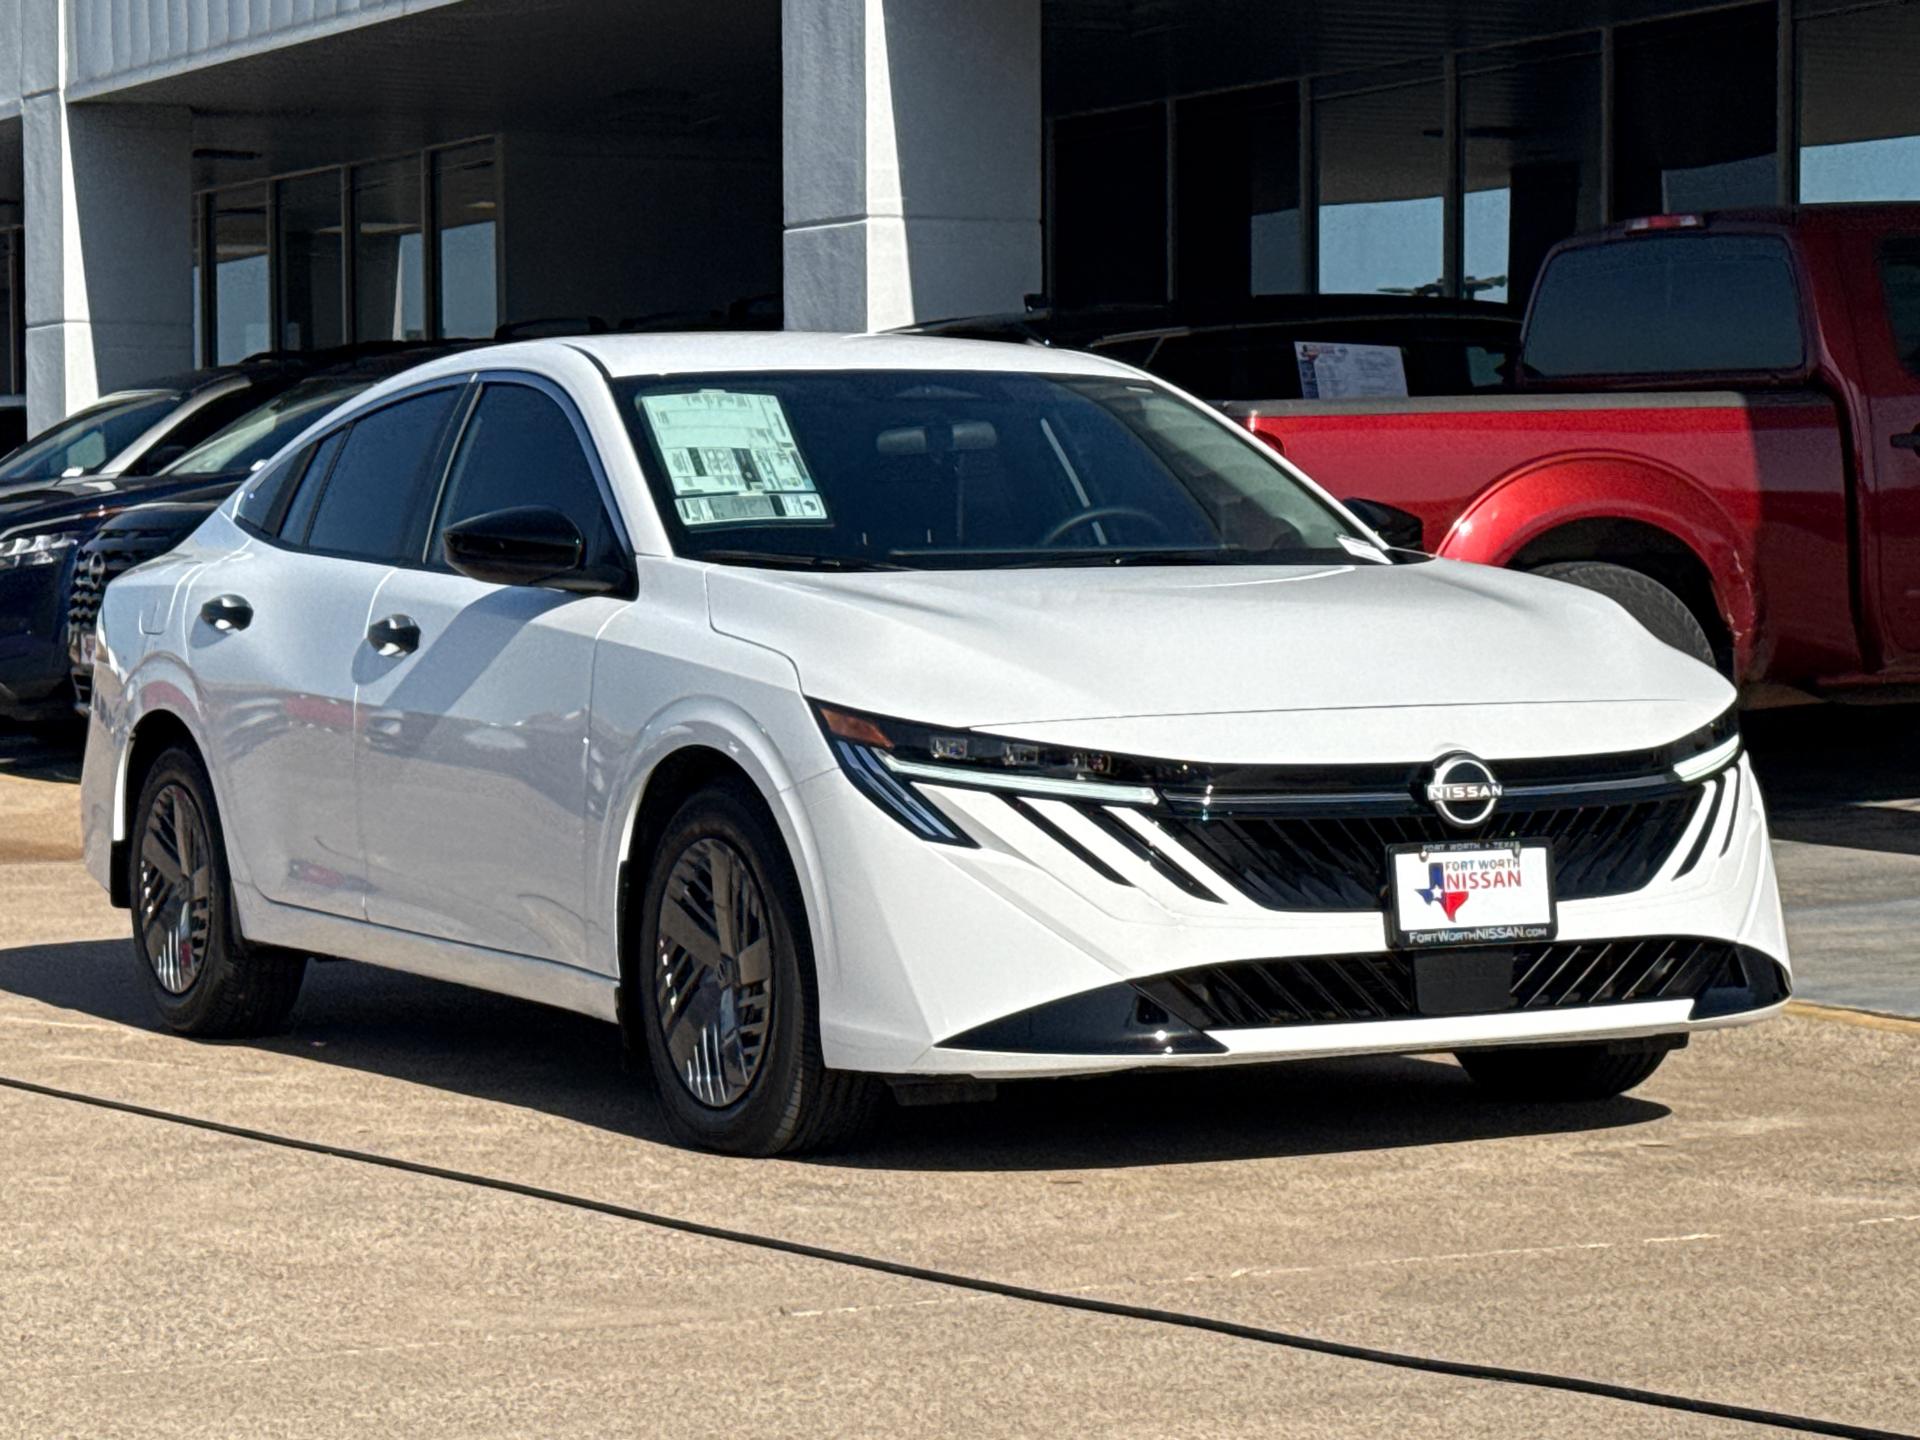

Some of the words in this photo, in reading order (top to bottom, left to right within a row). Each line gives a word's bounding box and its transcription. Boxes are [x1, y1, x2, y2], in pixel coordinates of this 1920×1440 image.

[1428, 785, 1502, 800] NISSAN
[1449, 842, 1481, 851] WORTH
[1445, 860, 1475, 872] FORT
[1478, 858, 1520, 871] WORTH
[1446, 870, 1521, 890] NISSAN
